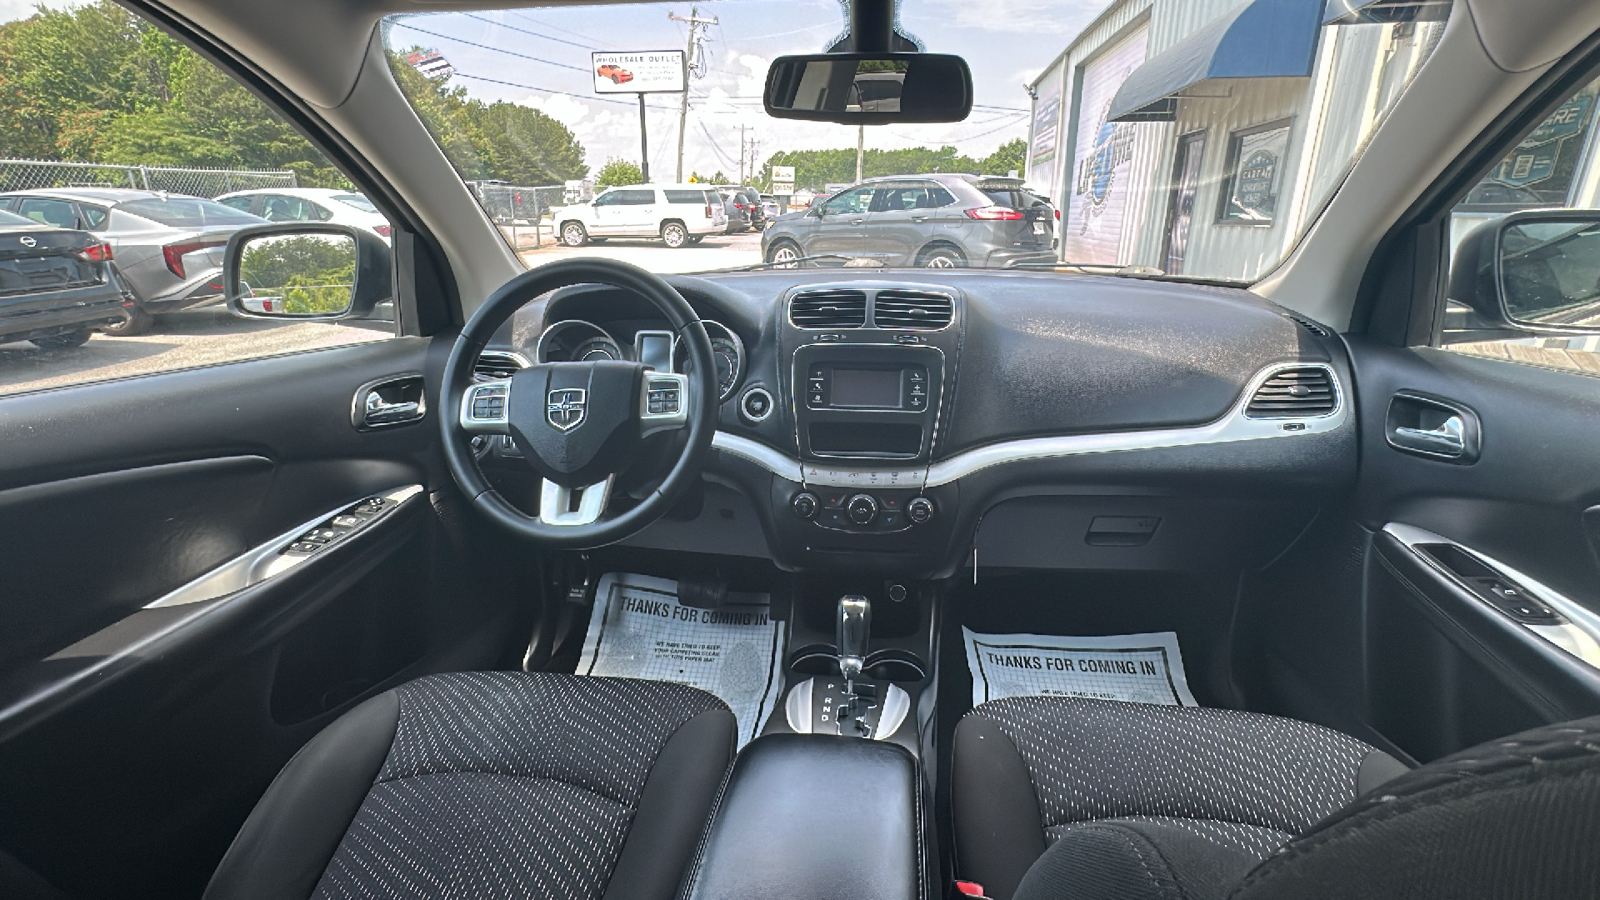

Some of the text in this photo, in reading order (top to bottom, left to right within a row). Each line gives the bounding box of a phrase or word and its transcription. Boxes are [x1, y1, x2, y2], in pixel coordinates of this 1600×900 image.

[648, 55, 680, 63] OUTLET
[621, 597, 768, 626] THANKS FOR COMING IN
[986, 652, 1157, 676] THANKS FOR COMING IN
